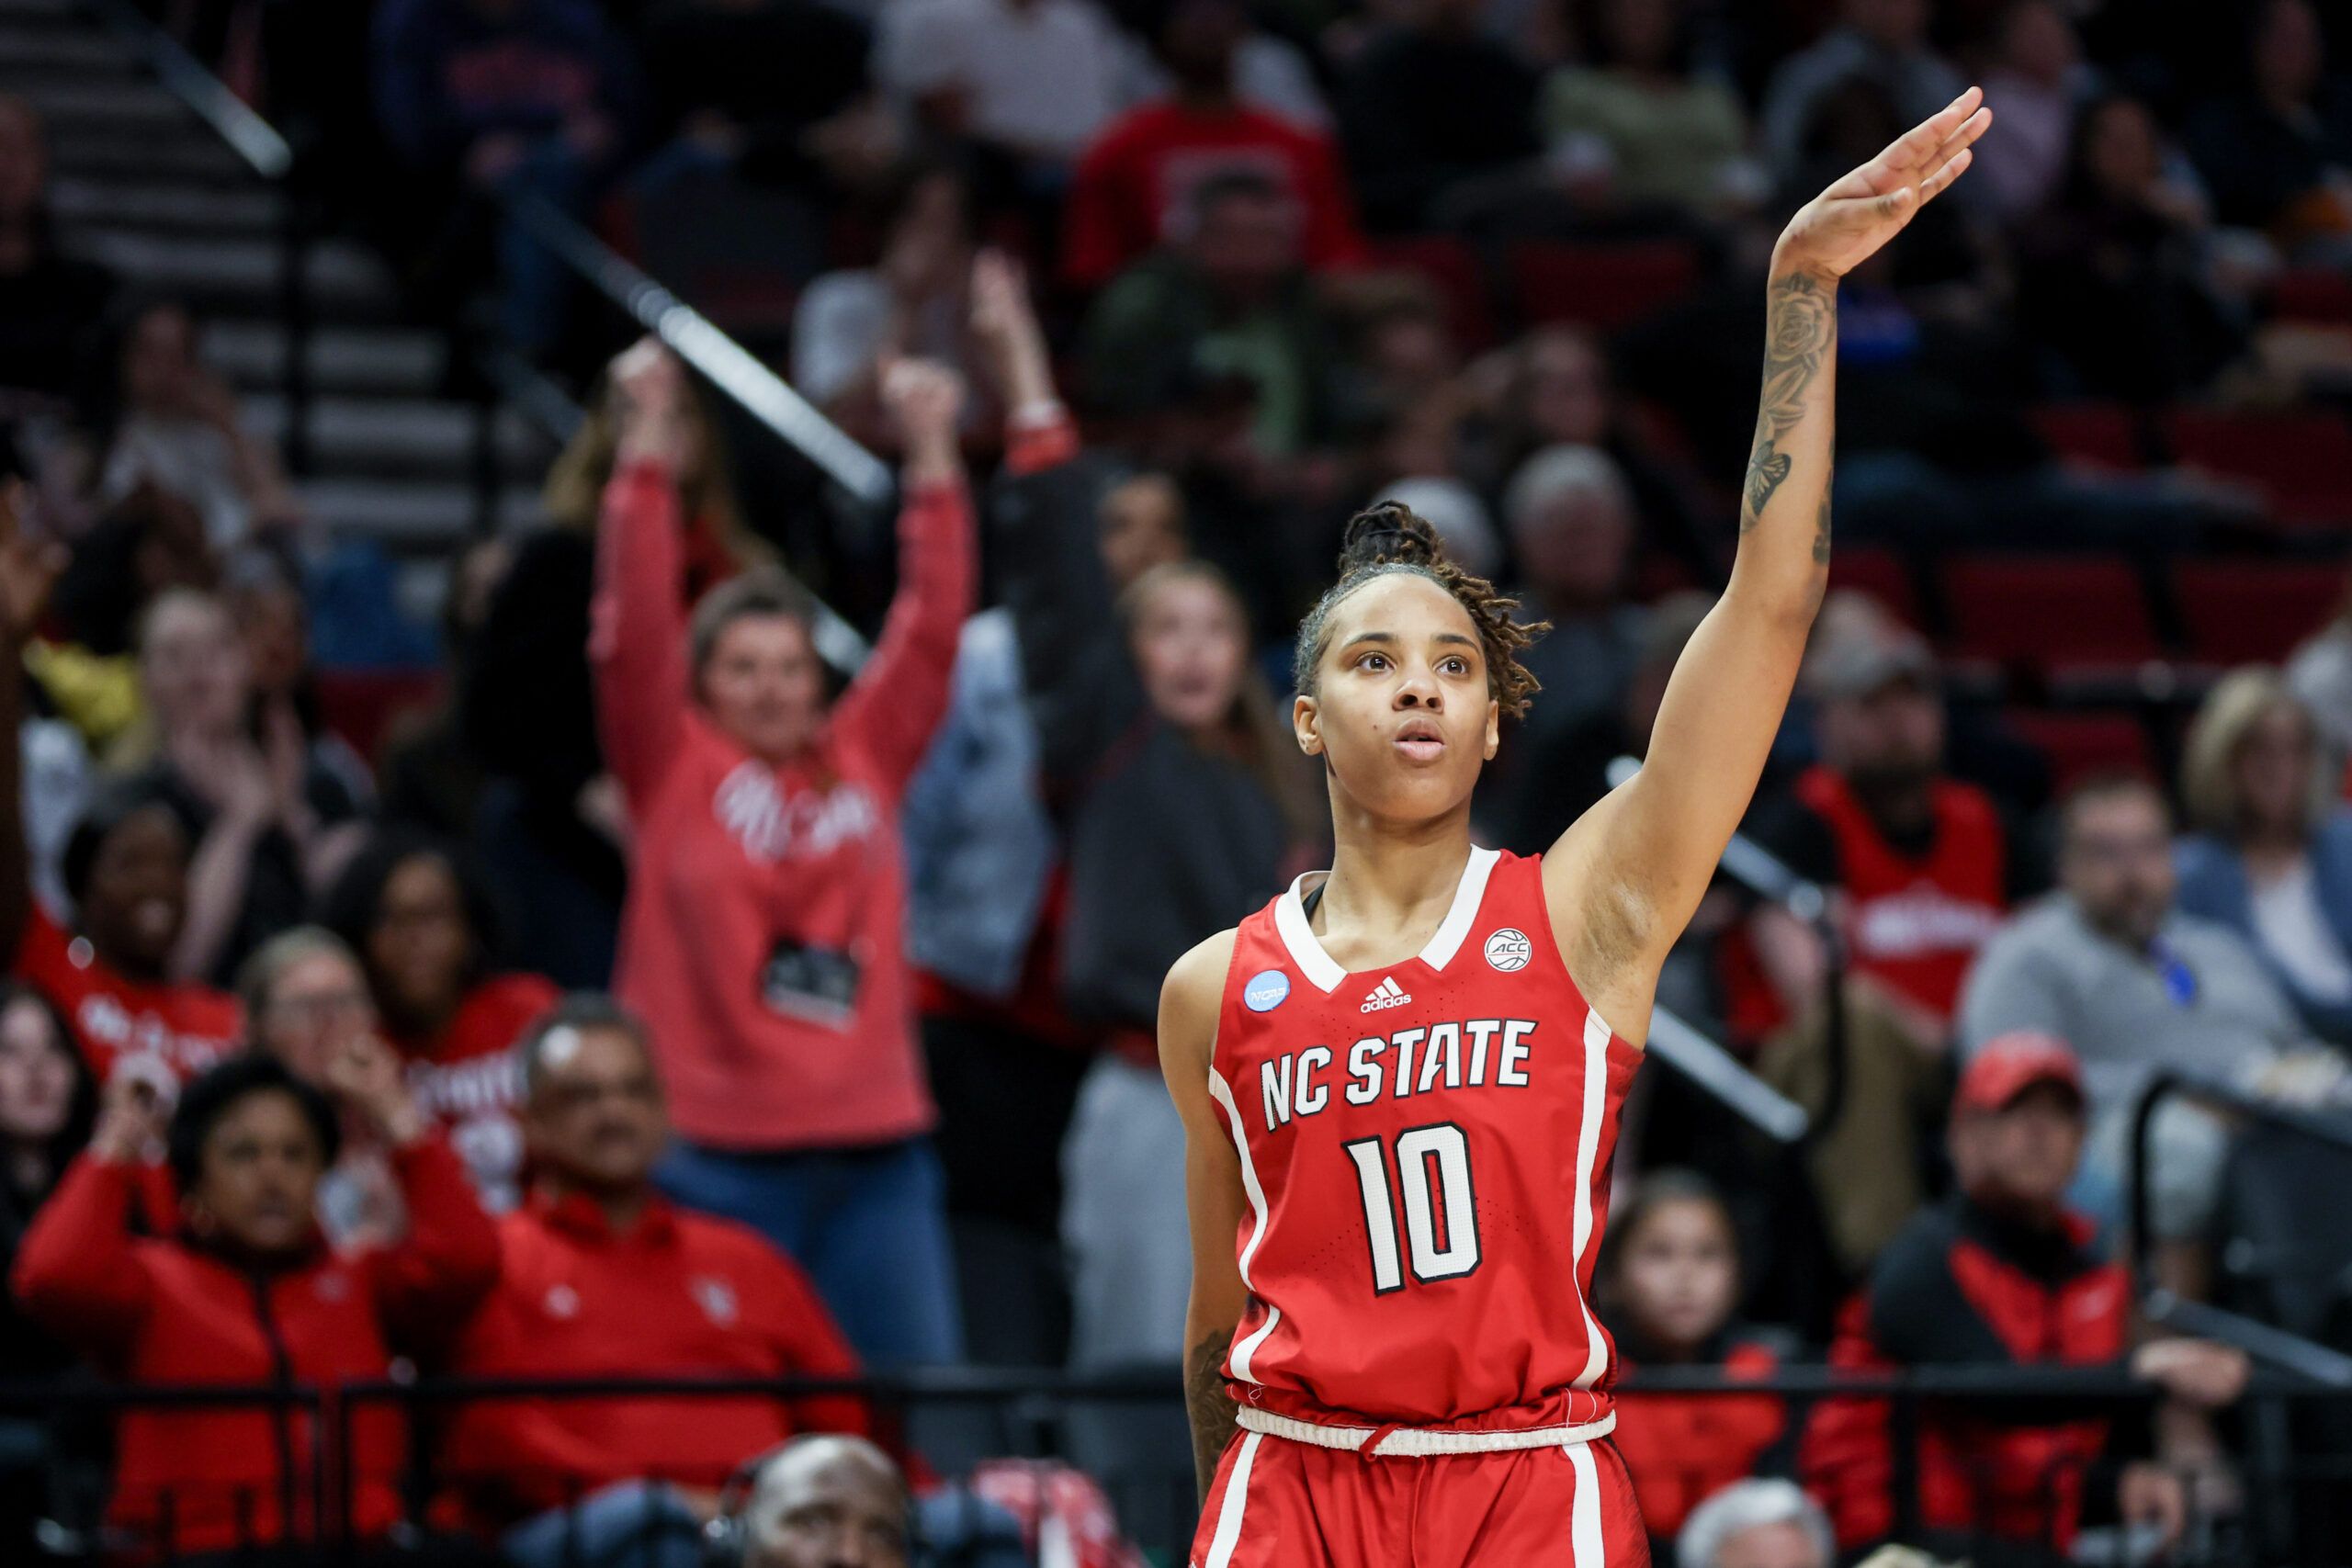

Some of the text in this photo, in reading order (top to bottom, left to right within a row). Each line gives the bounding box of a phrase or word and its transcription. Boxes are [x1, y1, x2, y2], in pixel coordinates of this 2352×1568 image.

[1492, 942, 1528, 953] ACC
[1361, 994, 1411, 1013] adidas
[1260, 1019, 1538, 1133] NC STATE
[1341, 1122, 1482, 1296] 10
